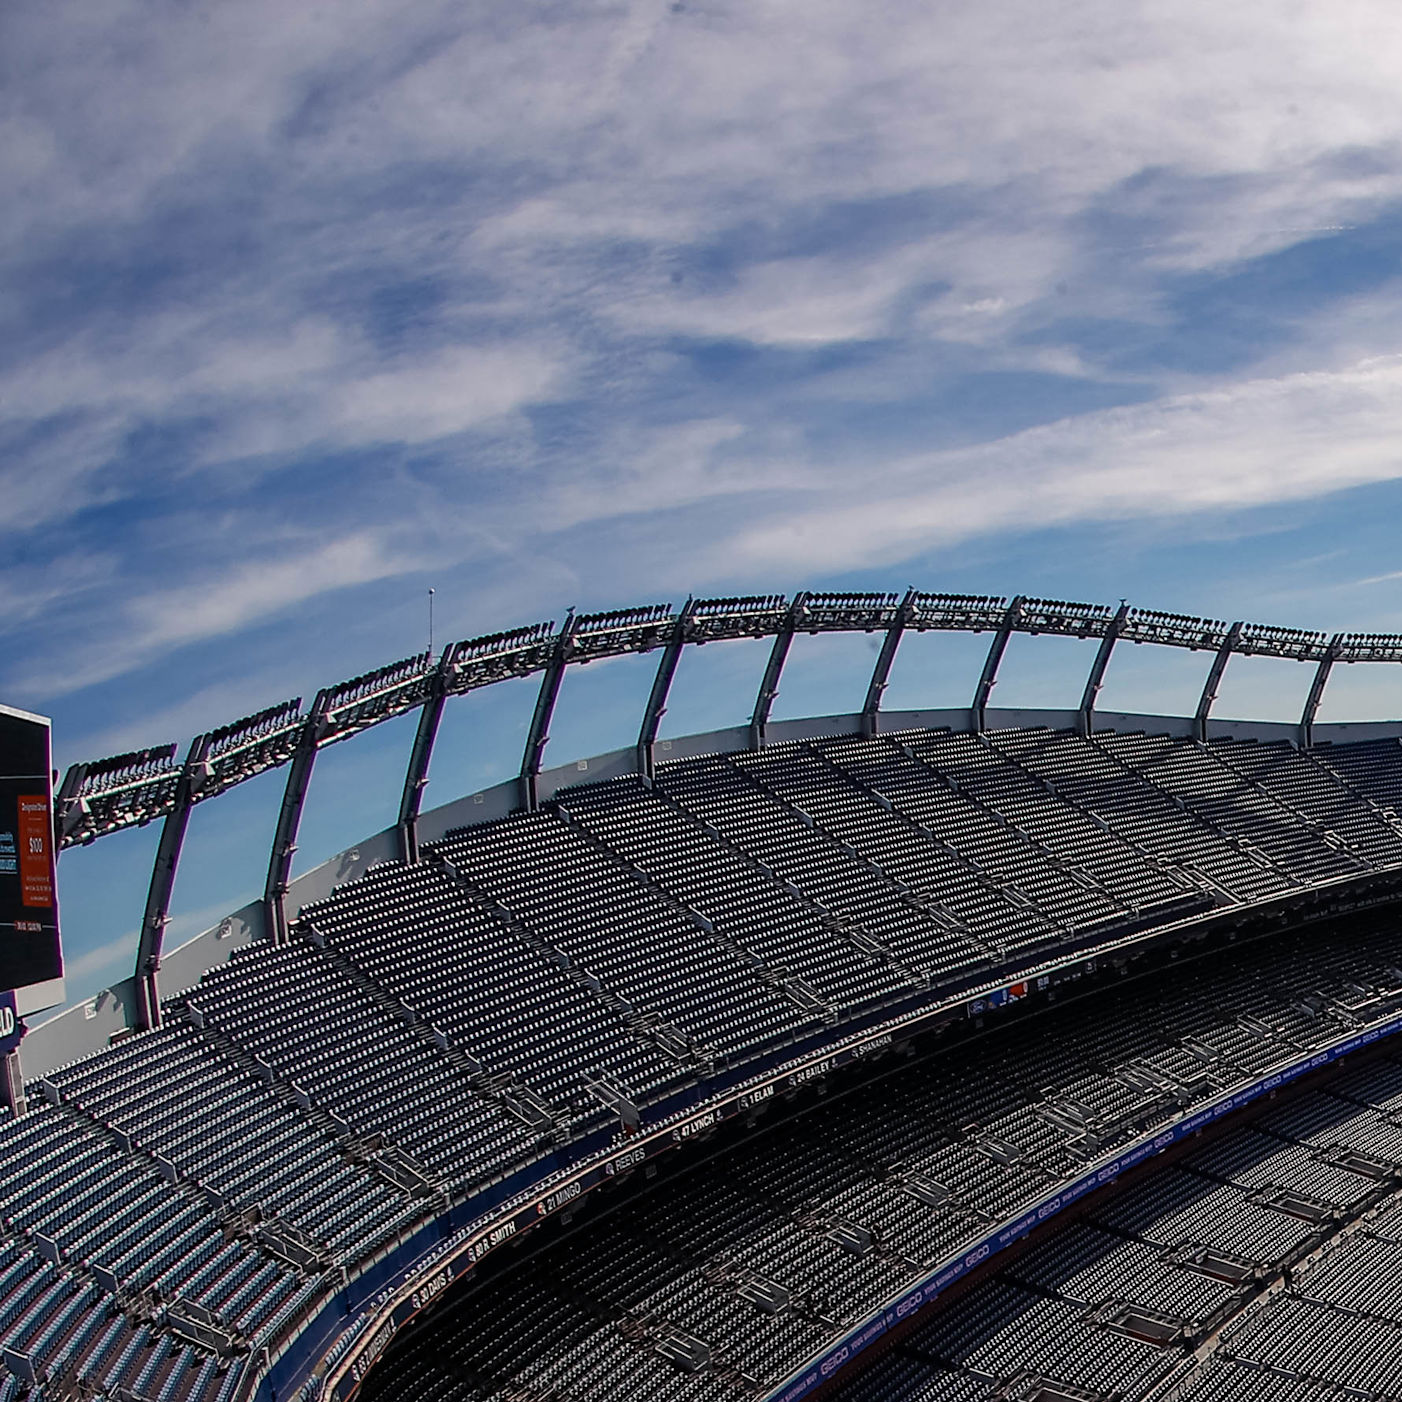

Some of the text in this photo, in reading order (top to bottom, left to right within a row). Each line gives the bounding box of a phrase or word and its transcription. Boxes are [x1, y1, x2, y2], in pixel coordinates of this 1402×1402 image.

[29, 837, 43, 853] $100
[859, 1034, 893, 1056] SHANAHAN
[806, 1061, 831, 1080] BAILEY
[755, 1085, 775, 1103] ELAM
[1213, 1099, 1234, 1116] GEICO
[681, 1113, 715, 1137] 47 LYNCH
[1153, 1131, 1174, 1149] GEICO
[615, 1148, 646, 1172] REEVES
[1097, 1162, 1120, 1183] GEICO
[546, 1182, 581, 1211] 21 MINGO
[1038, 1198, 1061, 1220] GEICO
[489, 1221, 517, 1246] SMITH
[965, 1244, 990, 1268] GEICO
[427, 1273, 447, 1296] DAVIS
[896, 1292, 923, 1318] GEICO
[820, 1346, 850, 1375] GEICO
